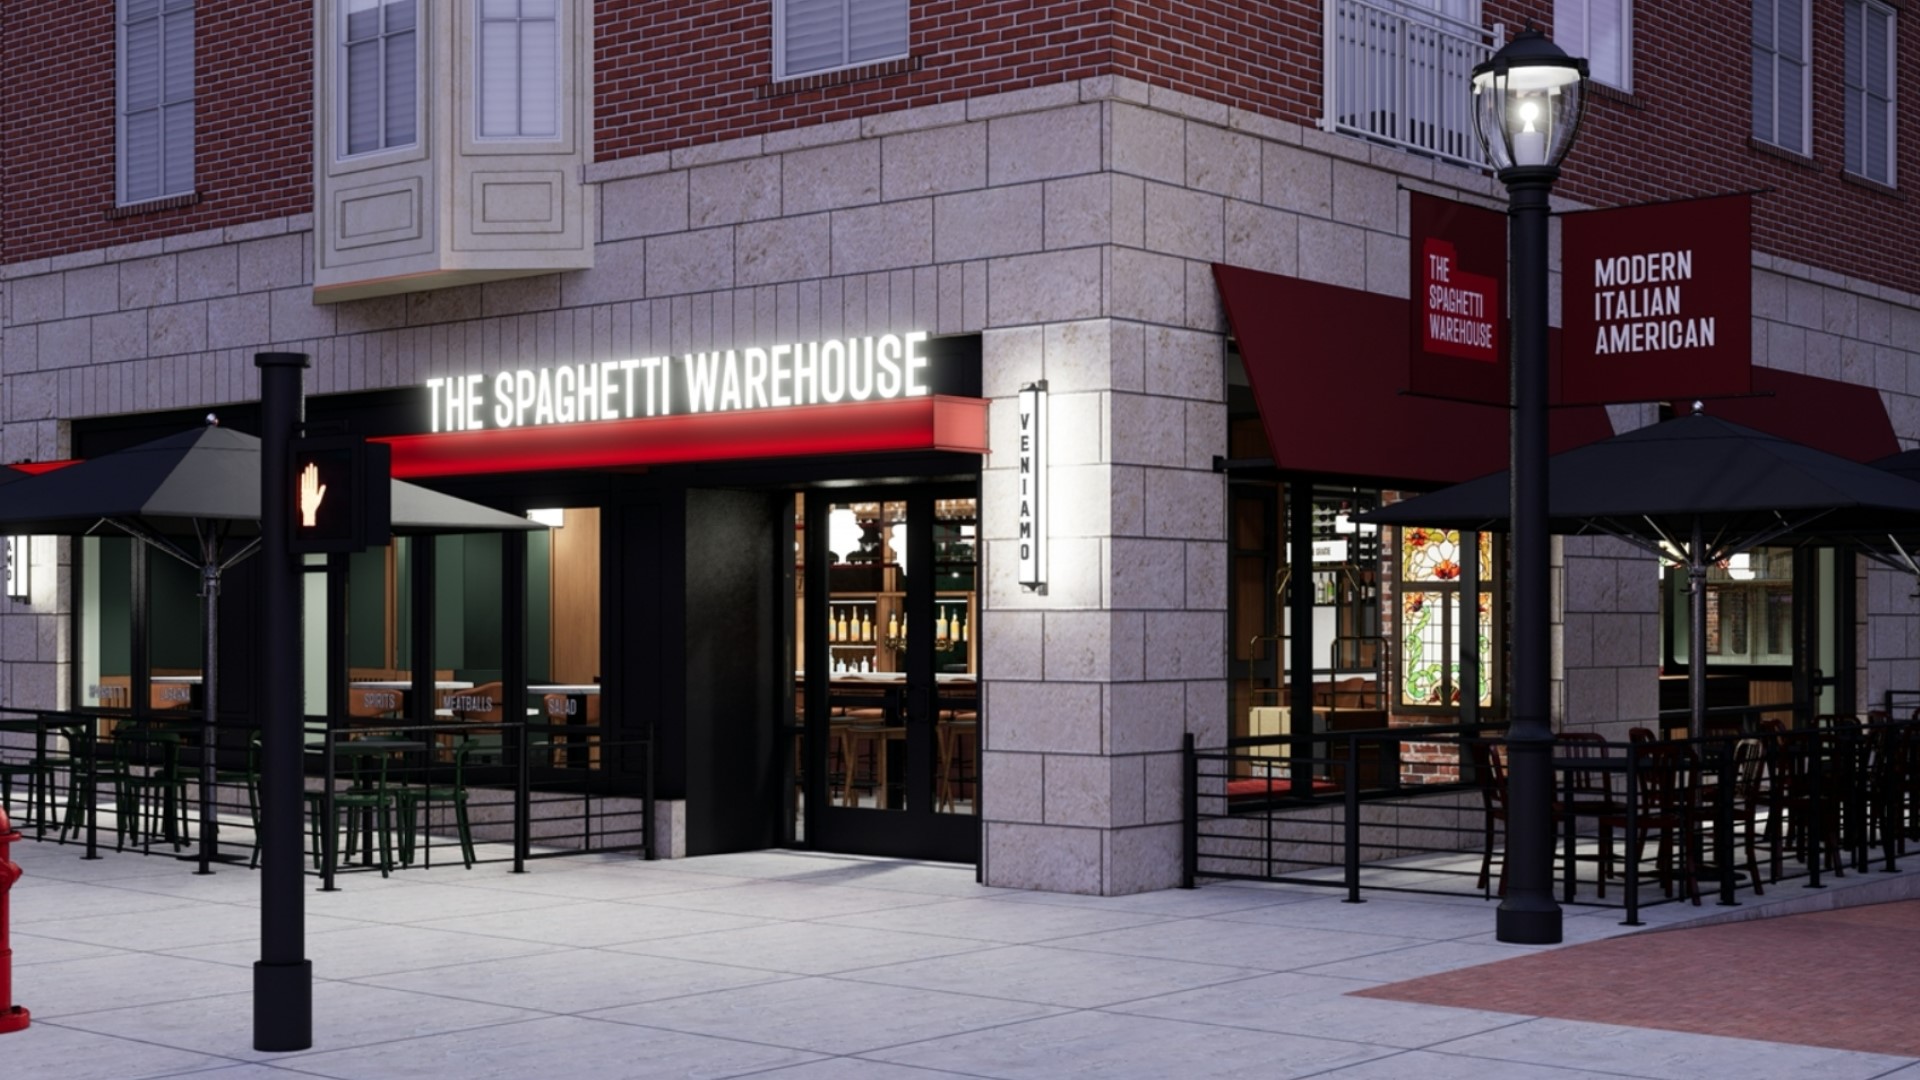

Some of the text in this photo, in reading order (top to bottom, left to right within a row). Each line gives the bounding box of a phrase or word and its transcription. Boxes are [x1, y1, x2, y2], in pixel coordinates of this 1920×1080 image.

[1429, 253, 1450, 283] THE
[1595, 249, 1692, 288] MODERN
[1429, 283, 1484, 319] SPAGHETTI
[1595, 285, 1681, 321] ITALIAN
[1429, 313, 1493, 349] WAREHOUSE
[1595, 316, 1715, 355] AMERICAN
[426, 330, 928, 433] THE SPAGHETTI WAREHOUSE
[1019, 412, 1031, 561] VENIAMO
[363, 692, 396, 710] SPIRITS
[443, 694, 493, 713] MEATBALLS
[547, 697, 577, 716] SALAD
